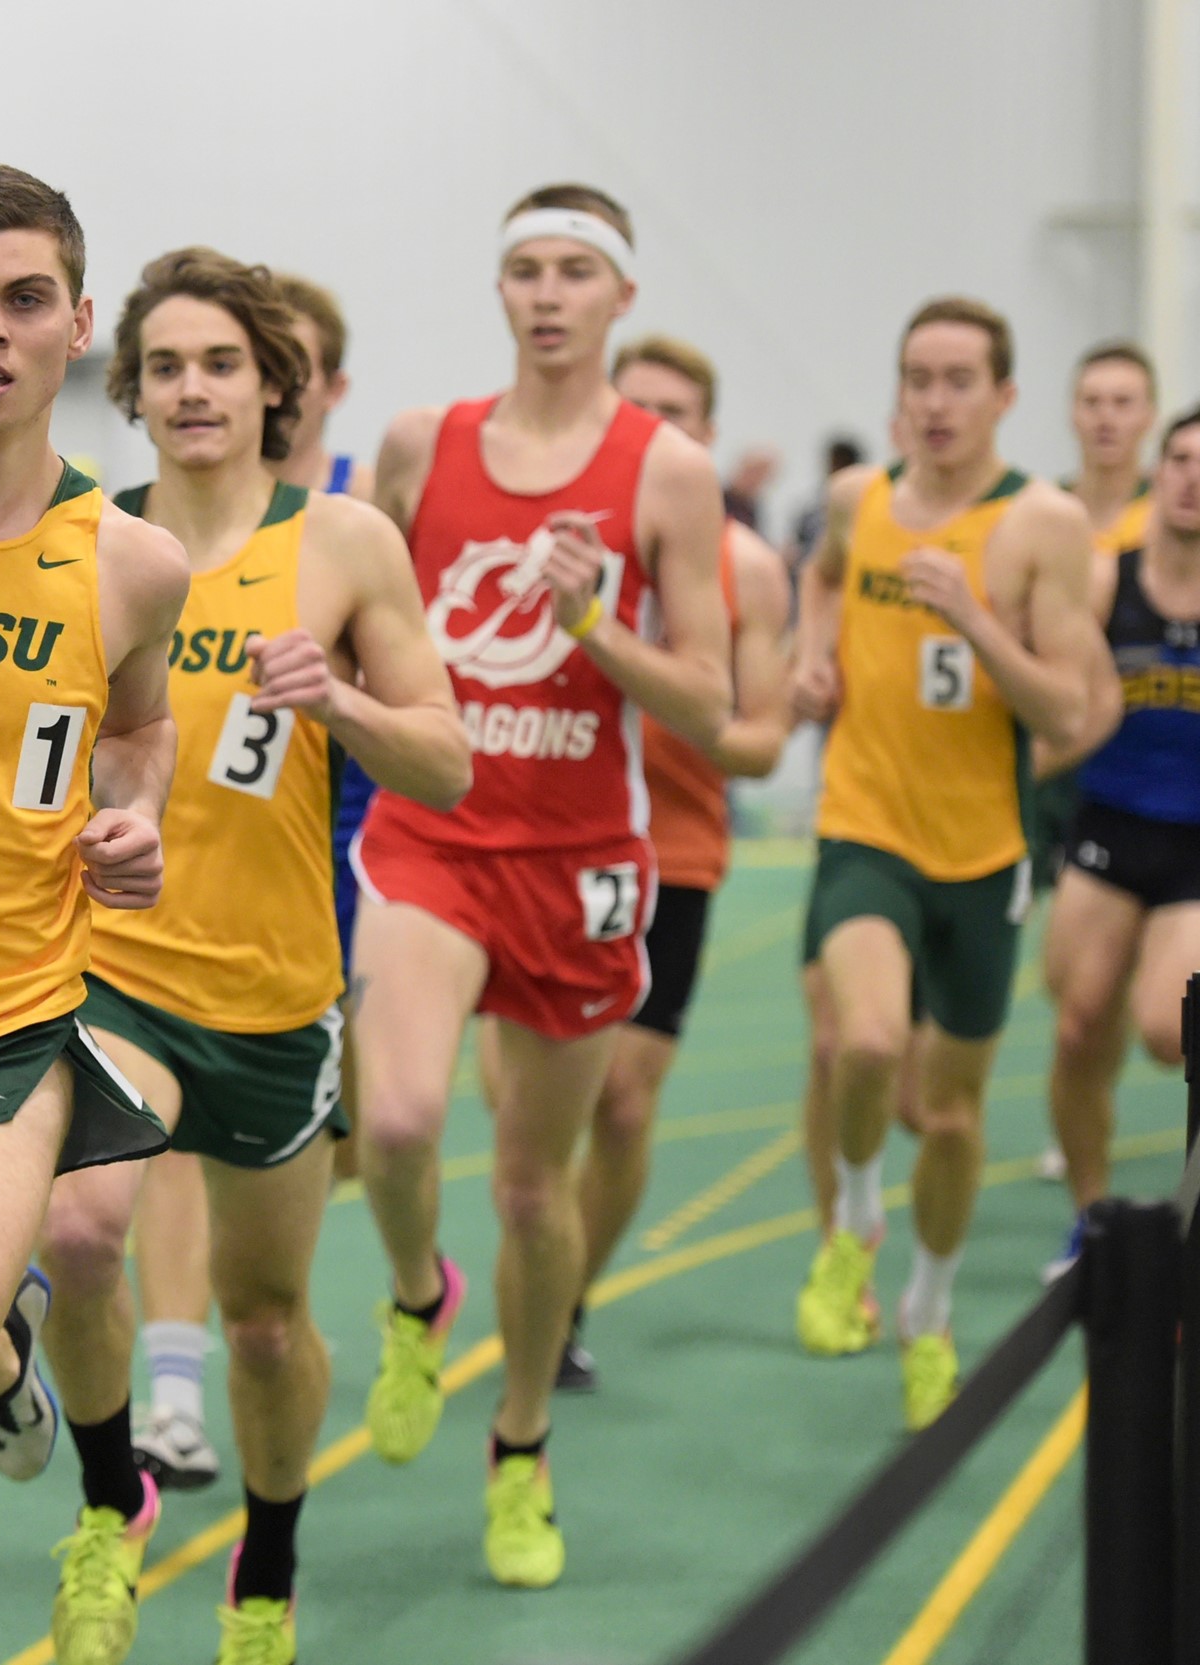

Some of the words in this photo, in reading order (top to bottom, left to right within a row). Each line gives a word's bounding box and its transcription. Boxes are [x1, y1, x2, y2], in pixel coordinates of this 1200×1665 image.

[935, 644, 962, 707] 5
[36, 715, 72, 805] 1
[226, 708, 278, 784] 3
[463, 700, 600, 761] AGONS
[596, 869, 623, 935] 2
